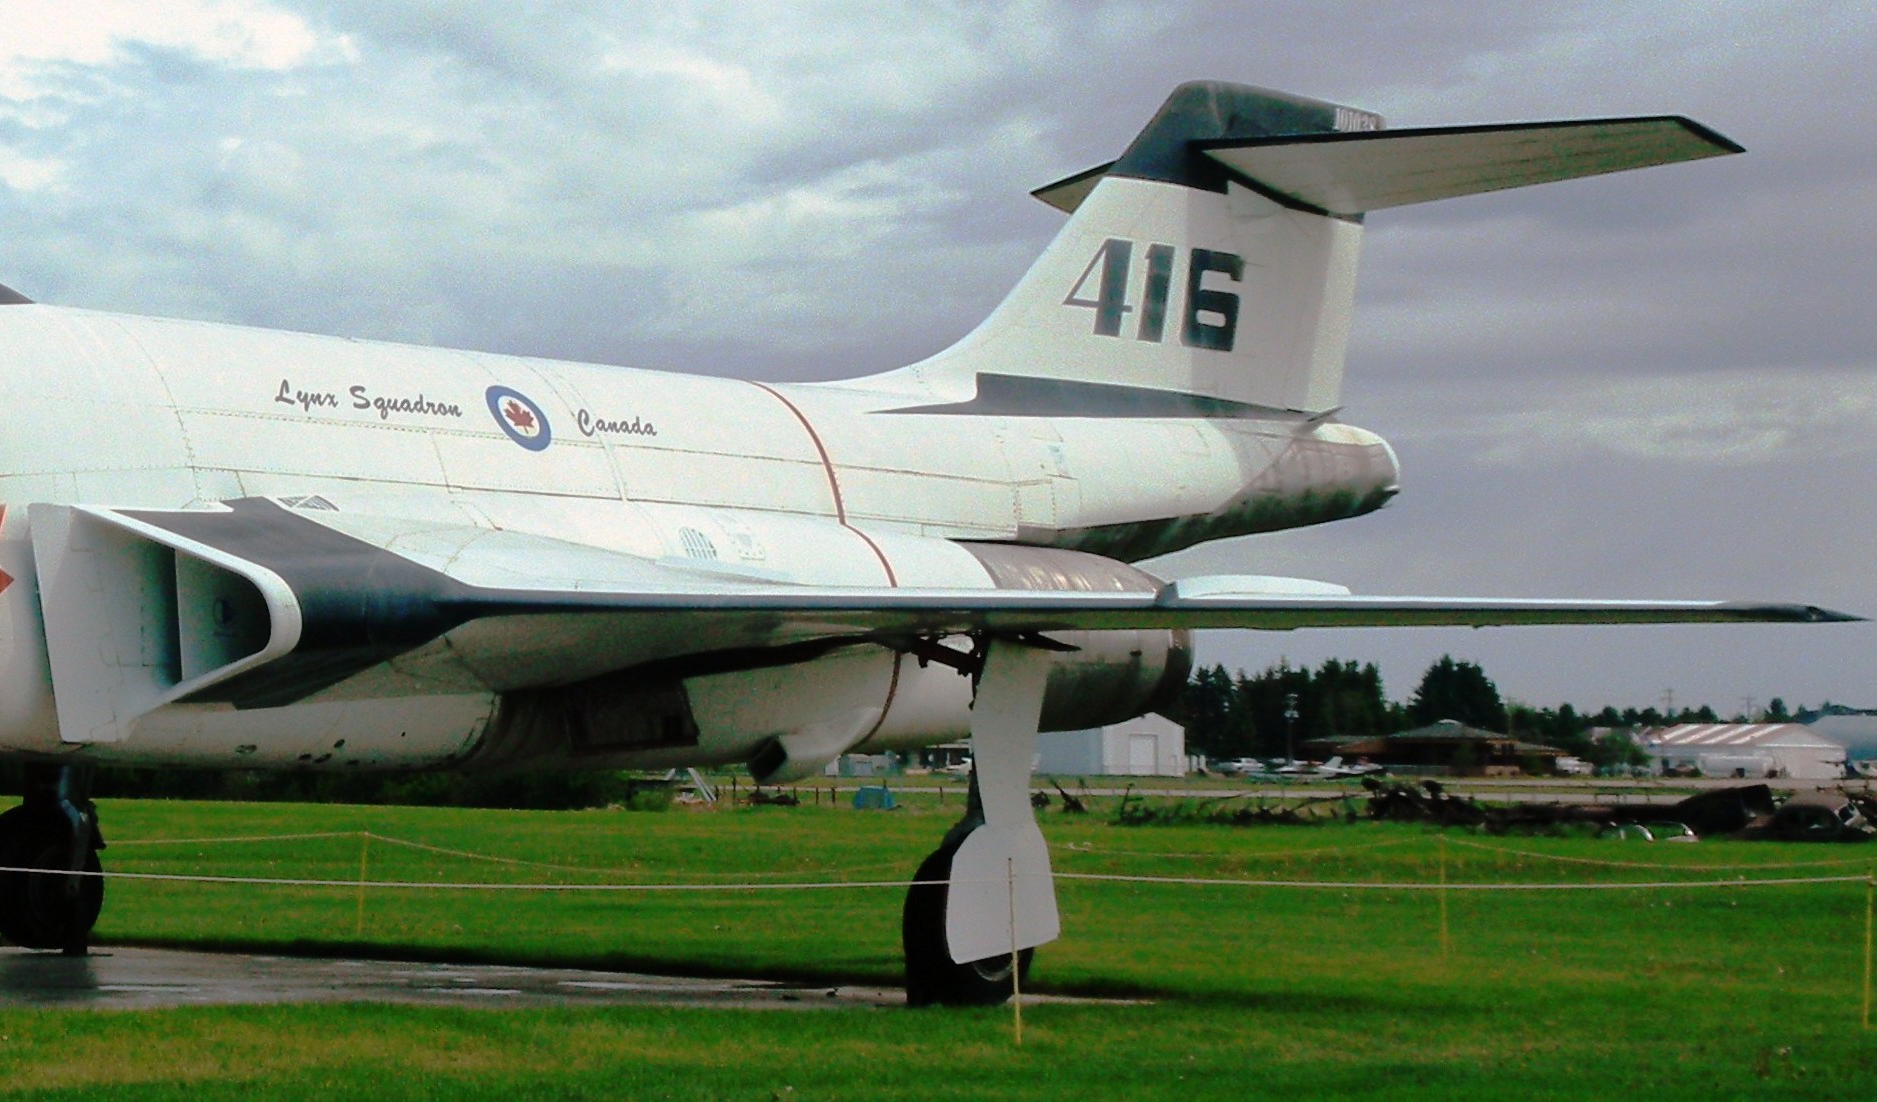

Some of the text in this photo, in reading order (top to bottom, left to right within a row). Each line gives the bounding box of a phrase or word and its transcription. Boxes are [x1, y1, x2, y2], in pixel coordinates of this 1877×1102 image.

[1062, 238, 1244, 352] 416
[274, 379, 463, 420] Lynx Squadron
[576, 409, 658, 437] Canada
